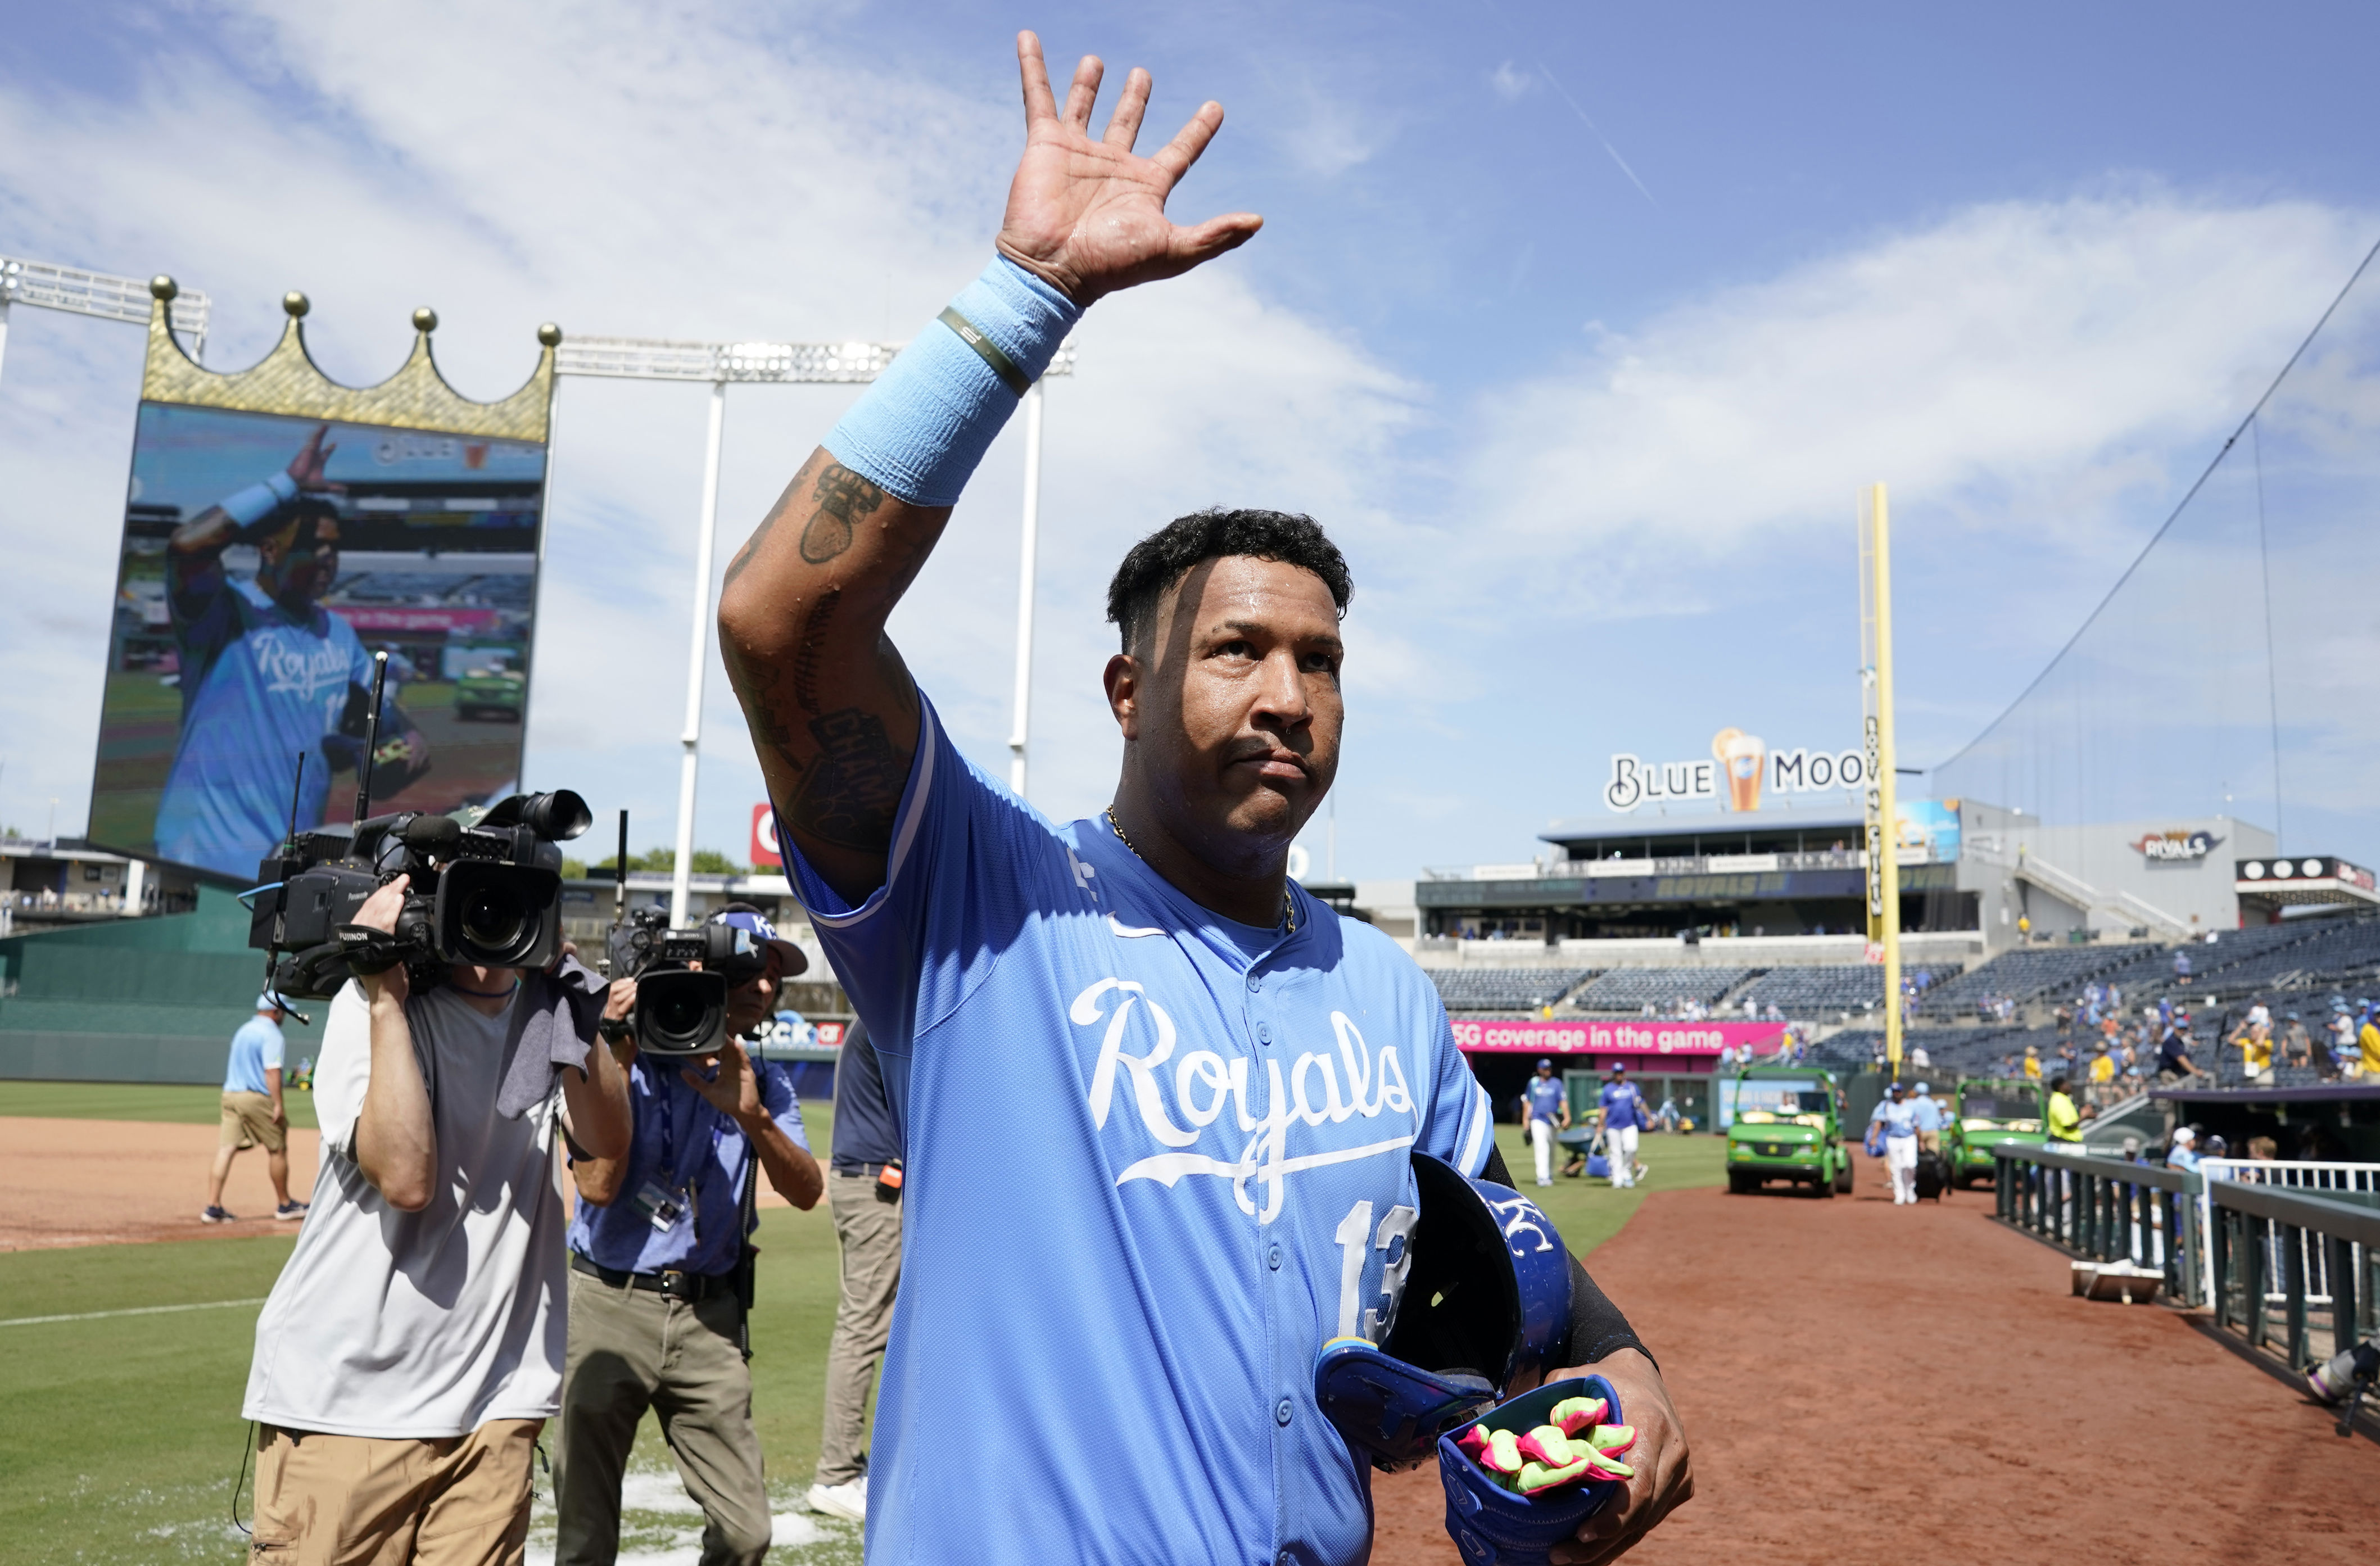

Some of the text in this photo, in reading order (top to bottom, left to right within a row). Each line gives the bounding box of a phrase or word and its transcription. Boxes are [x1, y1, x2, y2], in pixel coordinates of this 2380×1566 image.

[252, 631, 350, 701] Royals
[1775, 751, 1864, 789] MOO
[2145, 837, 2207, 859] RIVALS
[1485, 1028, 1586, 1052] coverage
[1590, 1025, 1611, 1048] in
[1615, 1025, 1654, 1048] the
[1657, 1029, 1724, 1053] game
[1070, 976, 1418, 1225] Royals
[1336, 1200, 1420, 1342] 13
